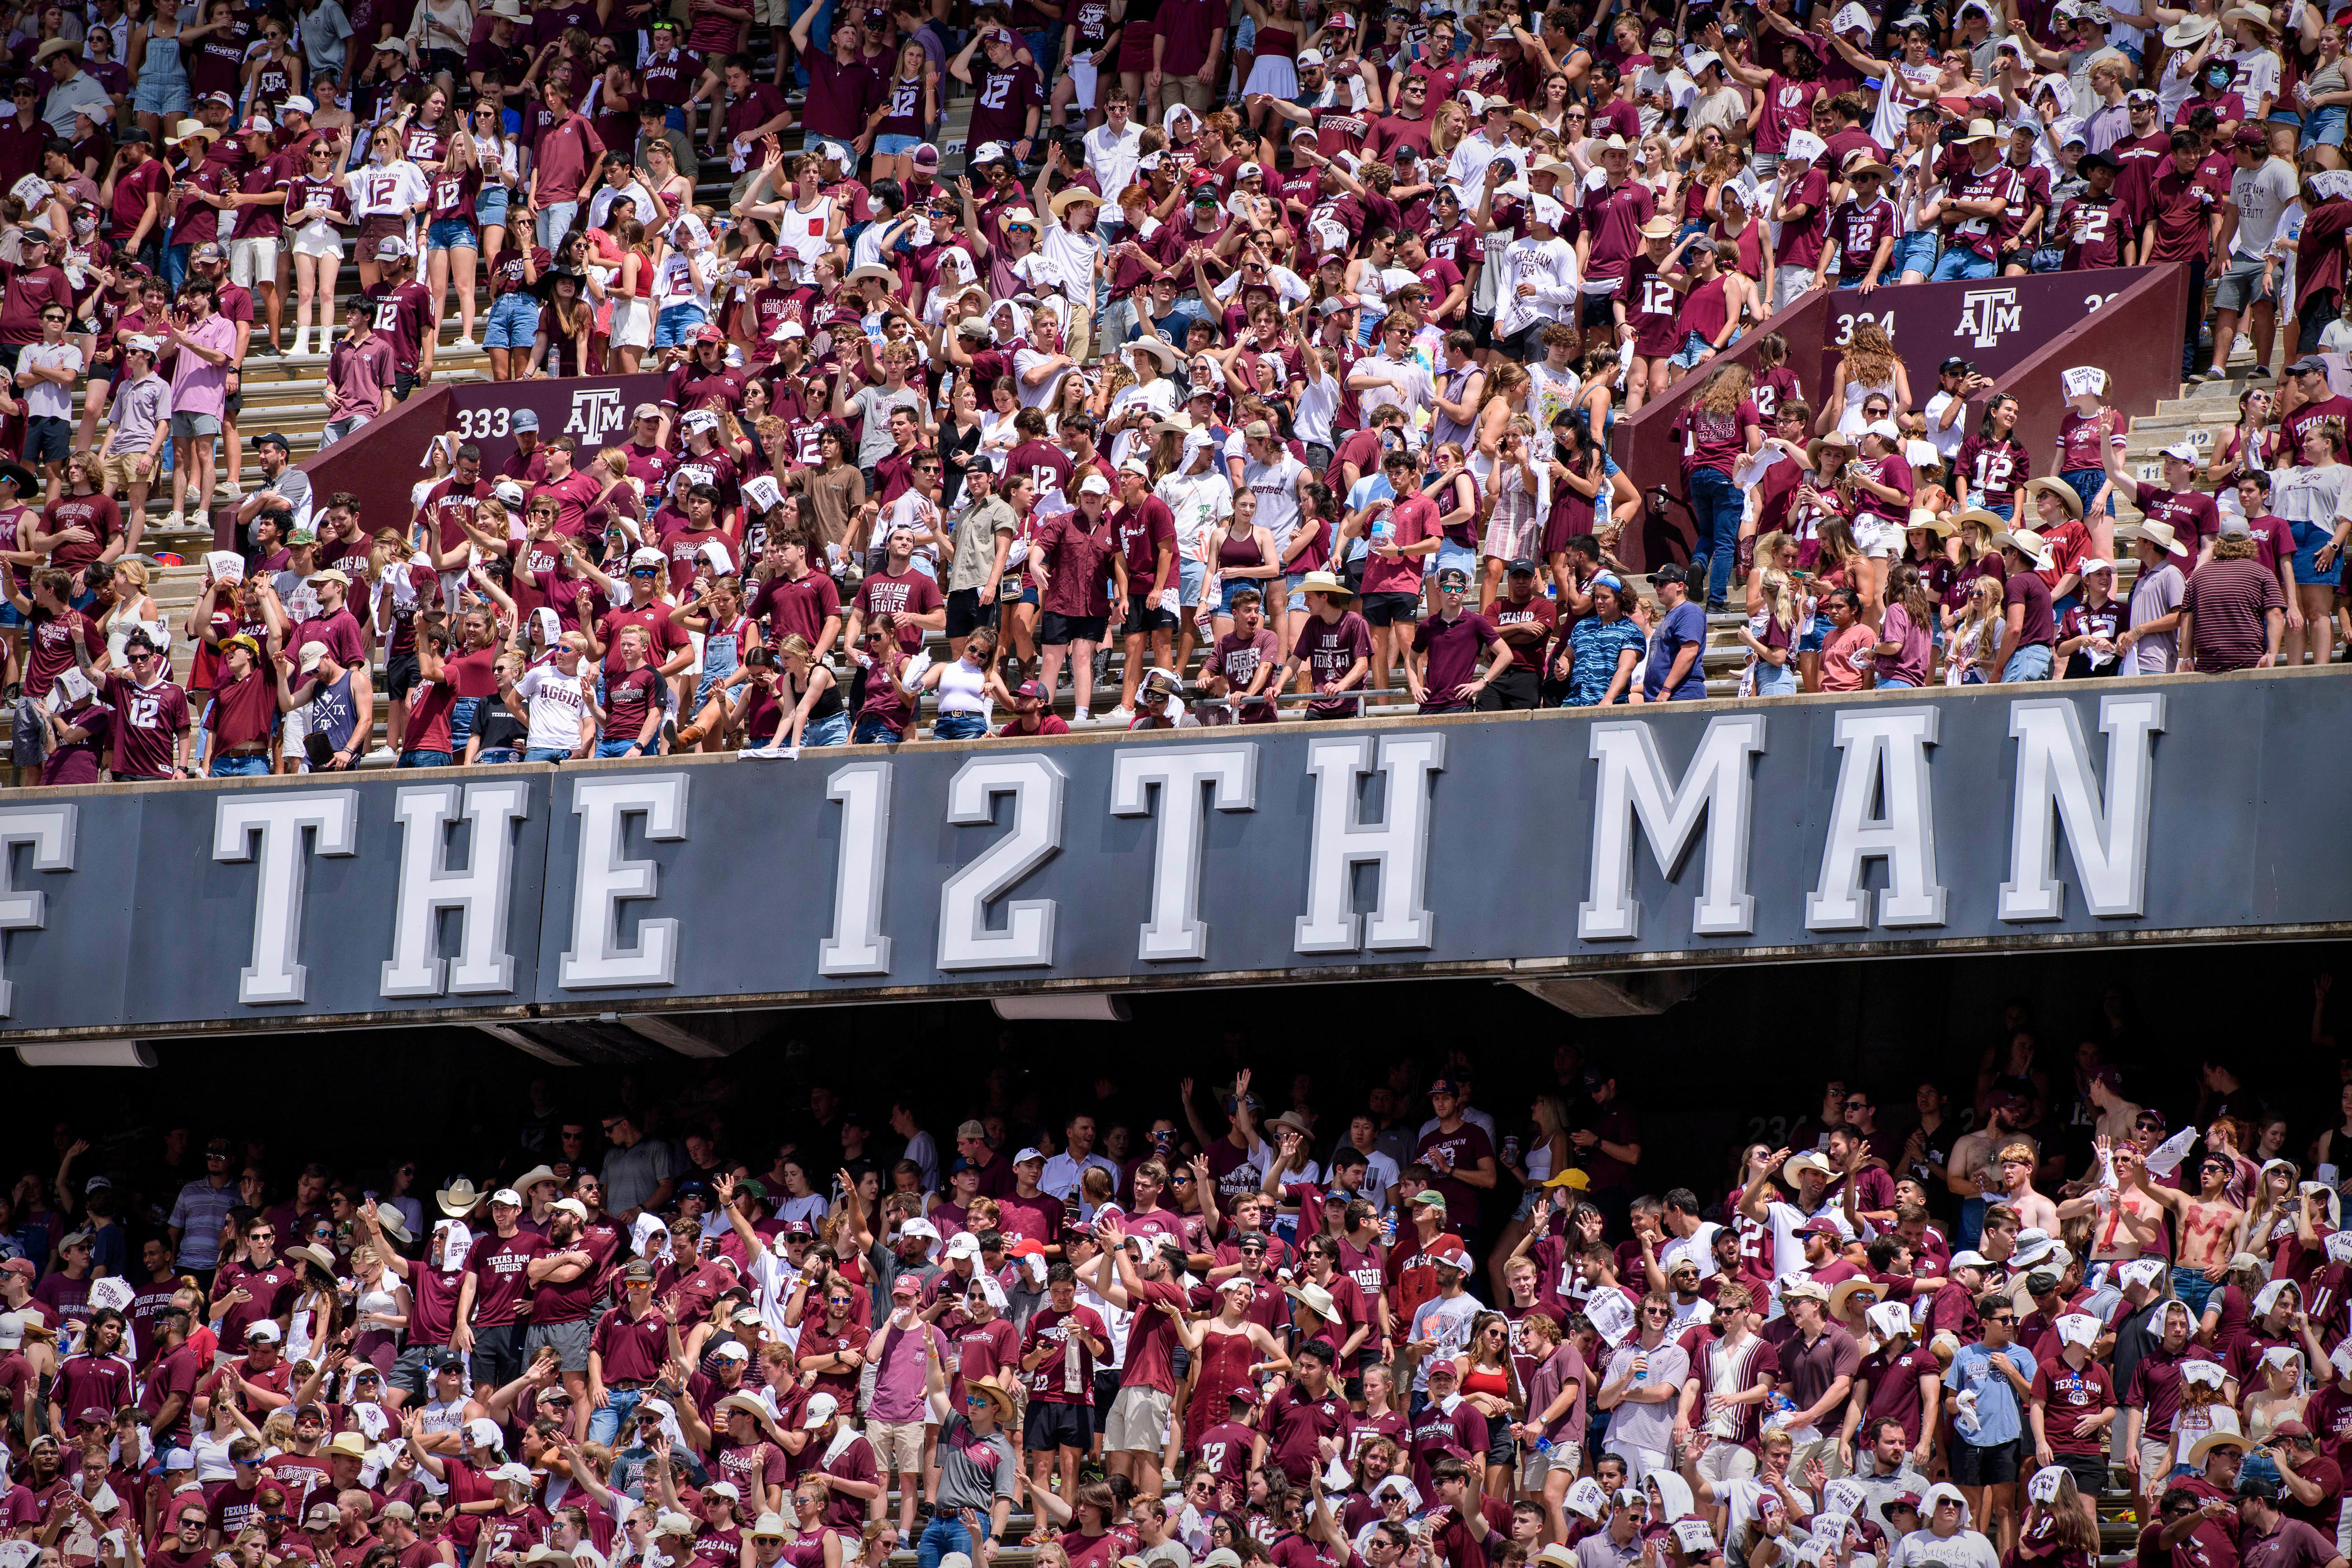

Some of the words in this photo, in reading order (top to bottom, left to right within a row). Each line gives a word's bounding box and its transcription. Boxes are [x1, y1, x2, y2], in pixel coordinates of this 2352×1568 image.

[205, 44, 241, 57] HOWDY
[980, 79, 1009, 108] 12
[889, 91, 916, 116] 12
[1591, 118, 1609, 128] GIES
[407, 135, 437, 159] 12
[367, 180, 396, 207] 12
[436, 182, 460, 210] 12
[1848, 224, 1872, 251] 12
[1642, 281, 1673, 315] 12
[374, 304, 397, 331] 12
[1836, 311, 1894, 346] 34
[1752, 385, 1774, 415] 12
[456, 407, 509, 440] 333
[1713, 429, 1735, 440] 2019
[795, 437, 823, 465] 12
[1031, 465, 1056, 495] 12
[1972, 454, 2014, 492] 12
[2285, 484, 2320, 493] Champion
[747, 527, 767, 554] 12
[332, 558, 354, 571] TEXAS
[871, 583, 889, 594] TEXAS
[871, 601, 905, 613] AGGIES
[1498, 610, 1520, 625] TEXAS
[1322, 634, 1338, 648] TRUE
[1226, 651, 1260, 674] AGGIES
[540, 685, 582, 706] AGGIE
[129, 698, 159, 728] 12
[333, 706, 346, 716] TX
[212, 772, 689, 1005] THE
[818, 732, 1446, 977] 12TH
[1578, 693, 2166, 941] MAN
[1441, 1138, 1467, 1149] DOWN
[1220, 1185, 1249, 1194] MAROON
[487, 1256, 508, 1266] TEXAS
[495, 1262, 522, 1274] AGGIES
[1348, 1268, 1381, 1287] AGGIE
[59, 1304, 90, 1315] BREAKAW
[134, 1296, 154, 1307] ROUGH
[1669, 1315, 1702, 1333] ggies
[1032, 1375, 1049, 1391] 22
[1996, 1372, 2008, 1383] 23
[1415, 1426, 1436, 1436] TEXAS
[1202, 1442, 1226, 1473] 12
[224, 1505, 248, 1517] TEXAS
[249, 1503, 259, 1513] A&
[224, 1524, 242, 1533] FORMER
[1249, 1520, 1280, 1545] 12
[1821, 1526, 1839, 1538] MAN
